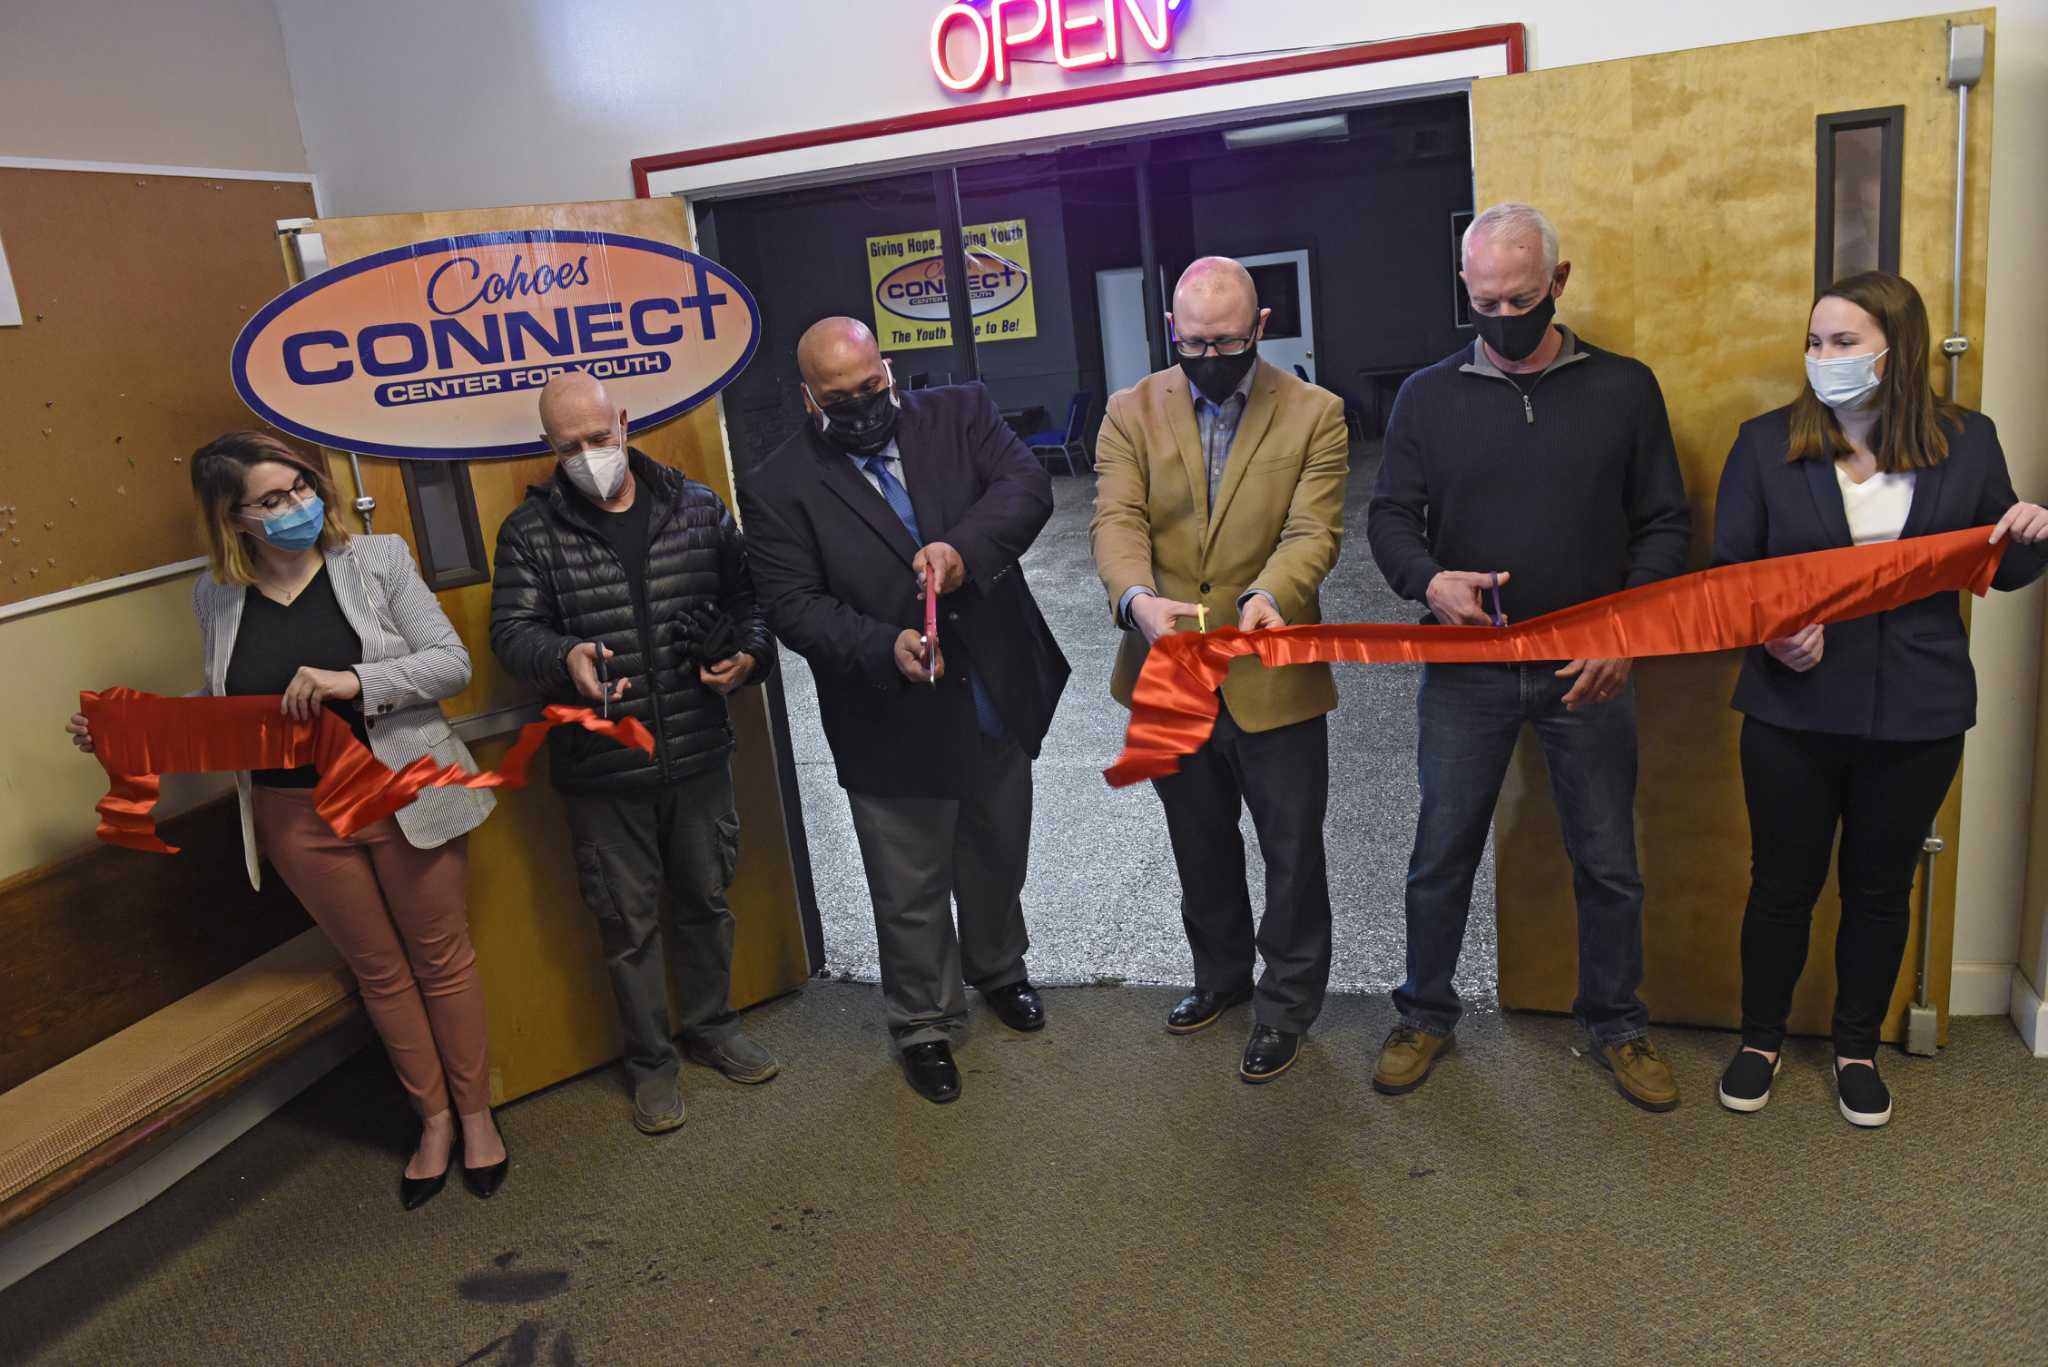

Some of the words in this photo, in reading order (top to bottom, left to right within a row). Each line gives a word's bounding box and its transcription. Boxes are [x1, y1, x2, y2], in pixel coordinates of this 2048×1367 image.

[930, 0, 1169, 90] OPEN
[870, 240, 904, 257] Giving
[907, 237, 936, 253] Hope
[960, 231, 986, 249] ping
[991, 223, 1023, 243] Youth
[427, 254, 588, 316] Cohoes
[887, 265, 1016, 299] CONECT
[892, 330, 911, 344] The
[916, 327, 946, 342] Youth
[986, 321, 998, 334] to
[1002, 319, 1020, 334] Be!
[387, 374, 501, 402] CENTER
